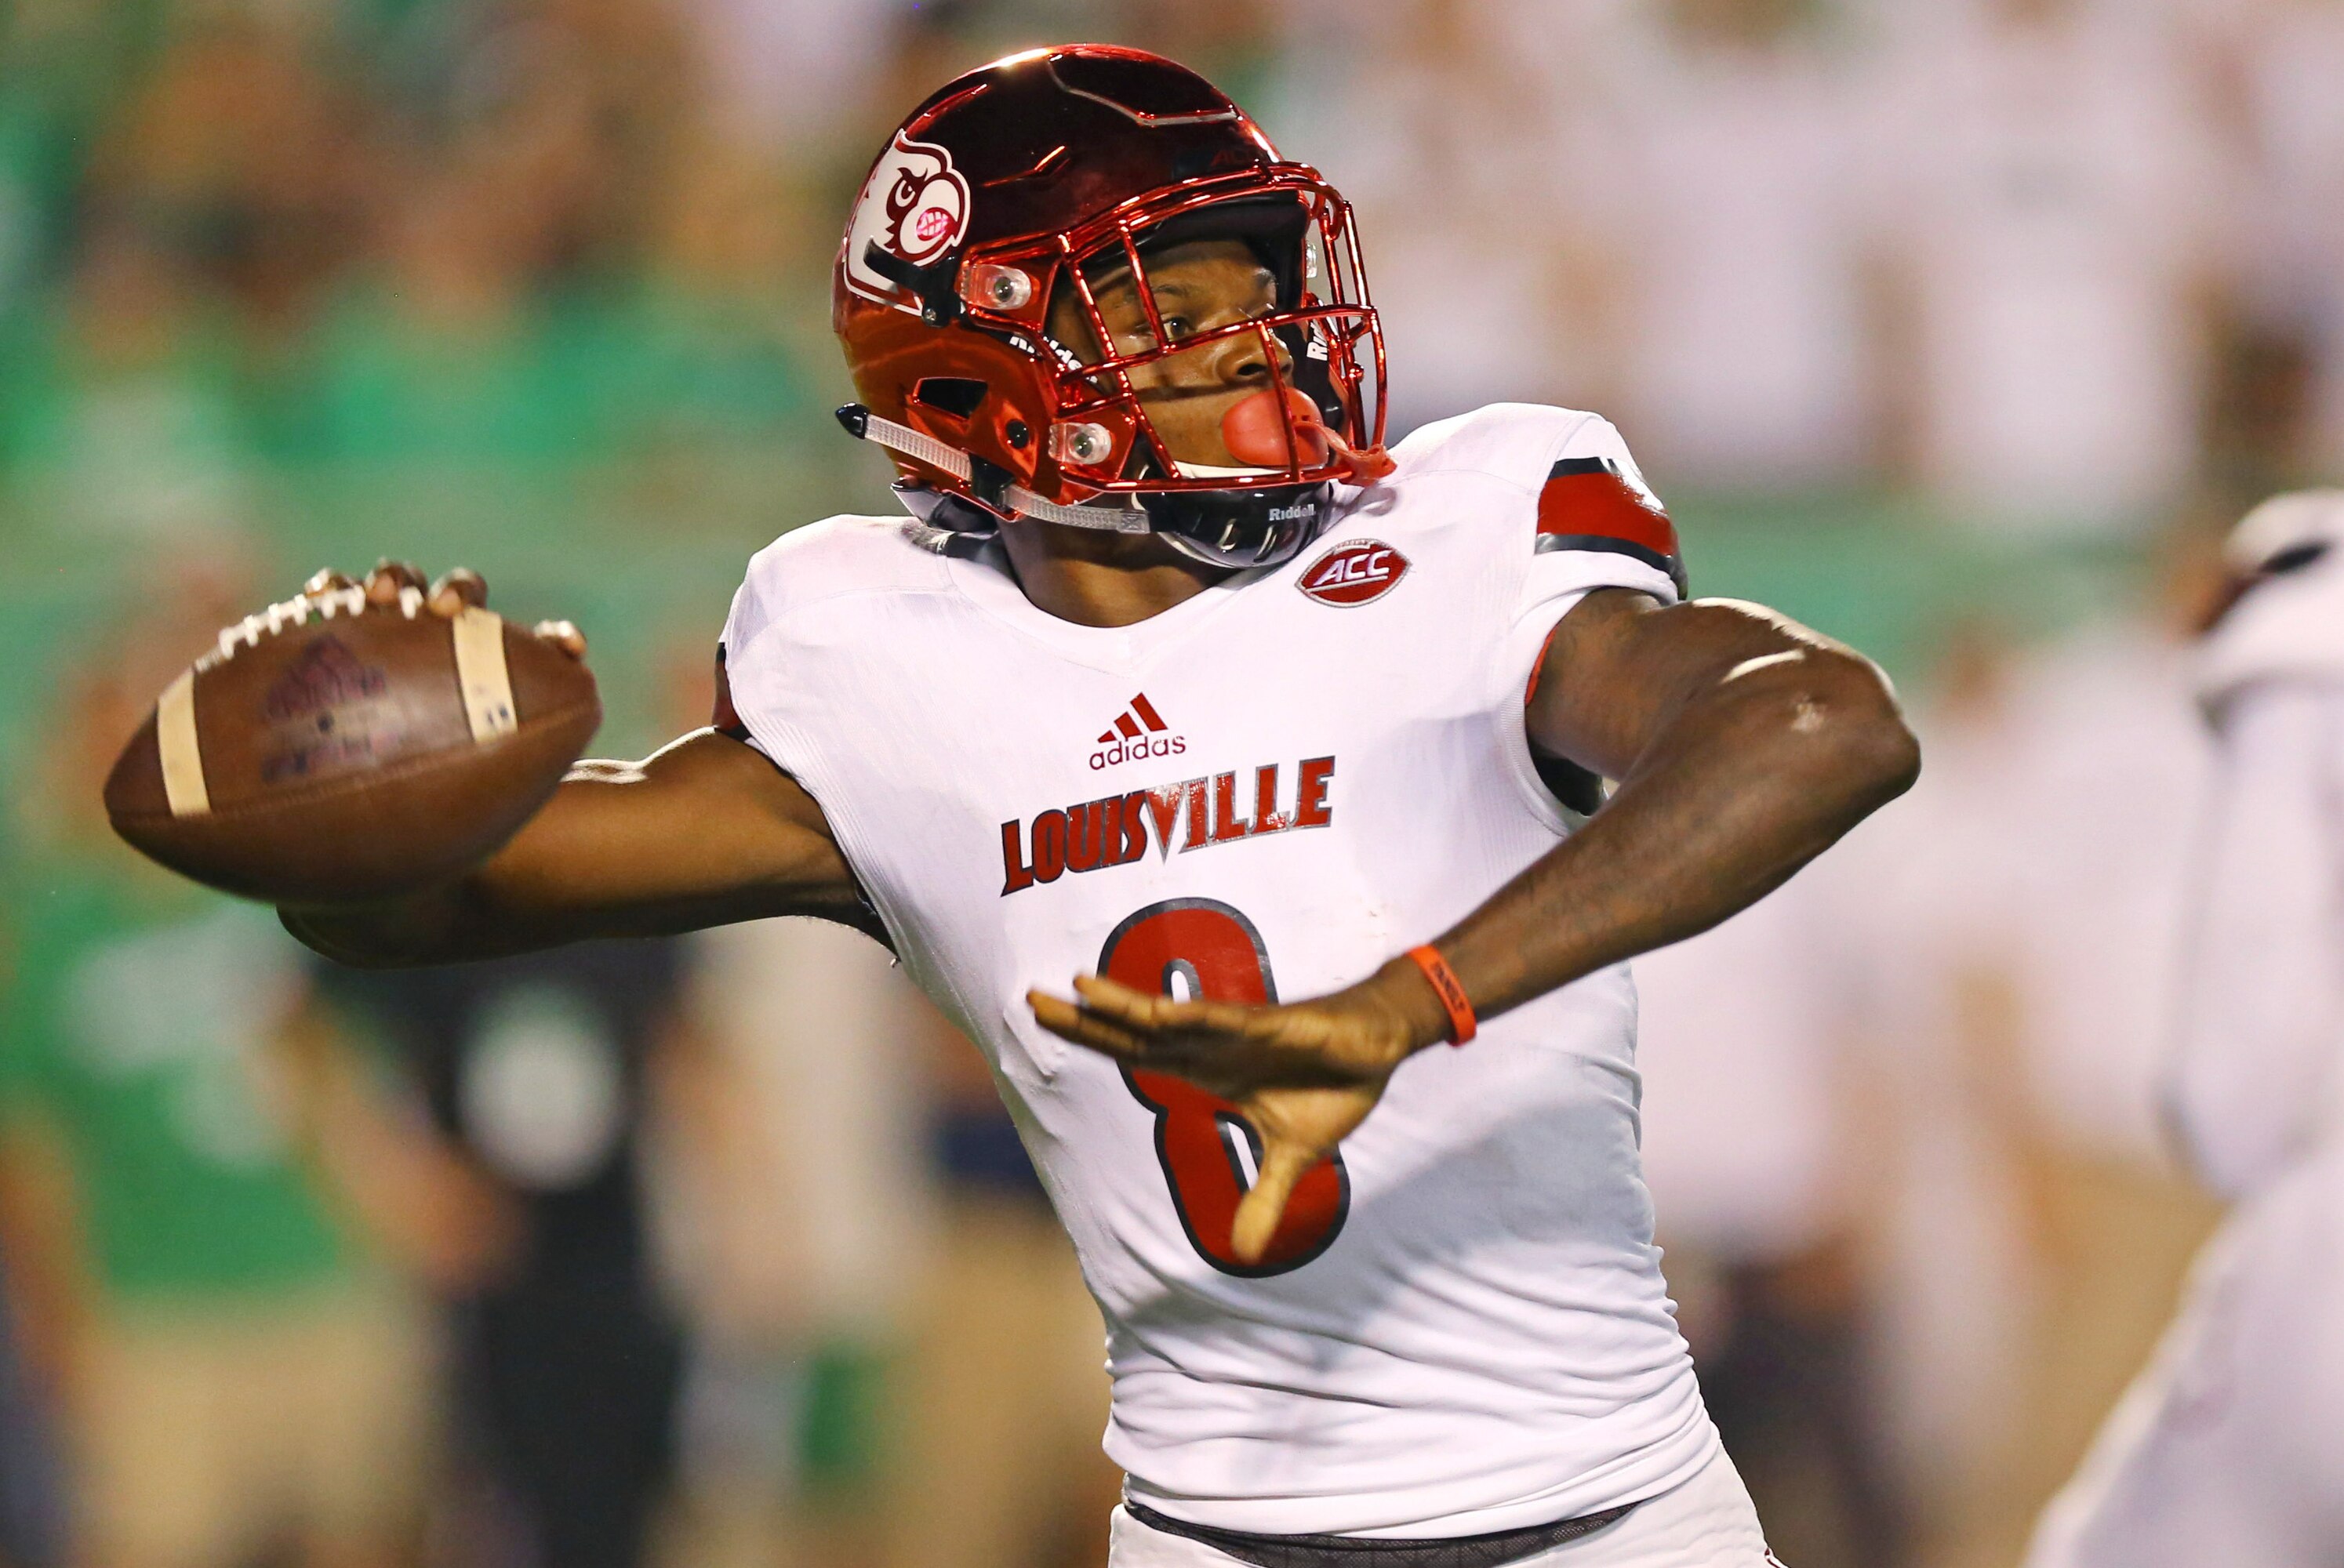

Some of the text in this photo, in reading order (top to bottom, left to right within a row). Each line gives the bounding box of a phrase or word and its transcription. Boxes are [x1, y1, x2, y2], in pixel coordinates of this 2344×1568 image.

[1269, 503, 1315, 521] Riddell
[1313, 550, 1393, 586] ACC
[1089, 735, 1187, 771] adidas
[1001, 755, 1336, 897] LOUISVILLE
[1096, 897, 1351, 1278] 8
